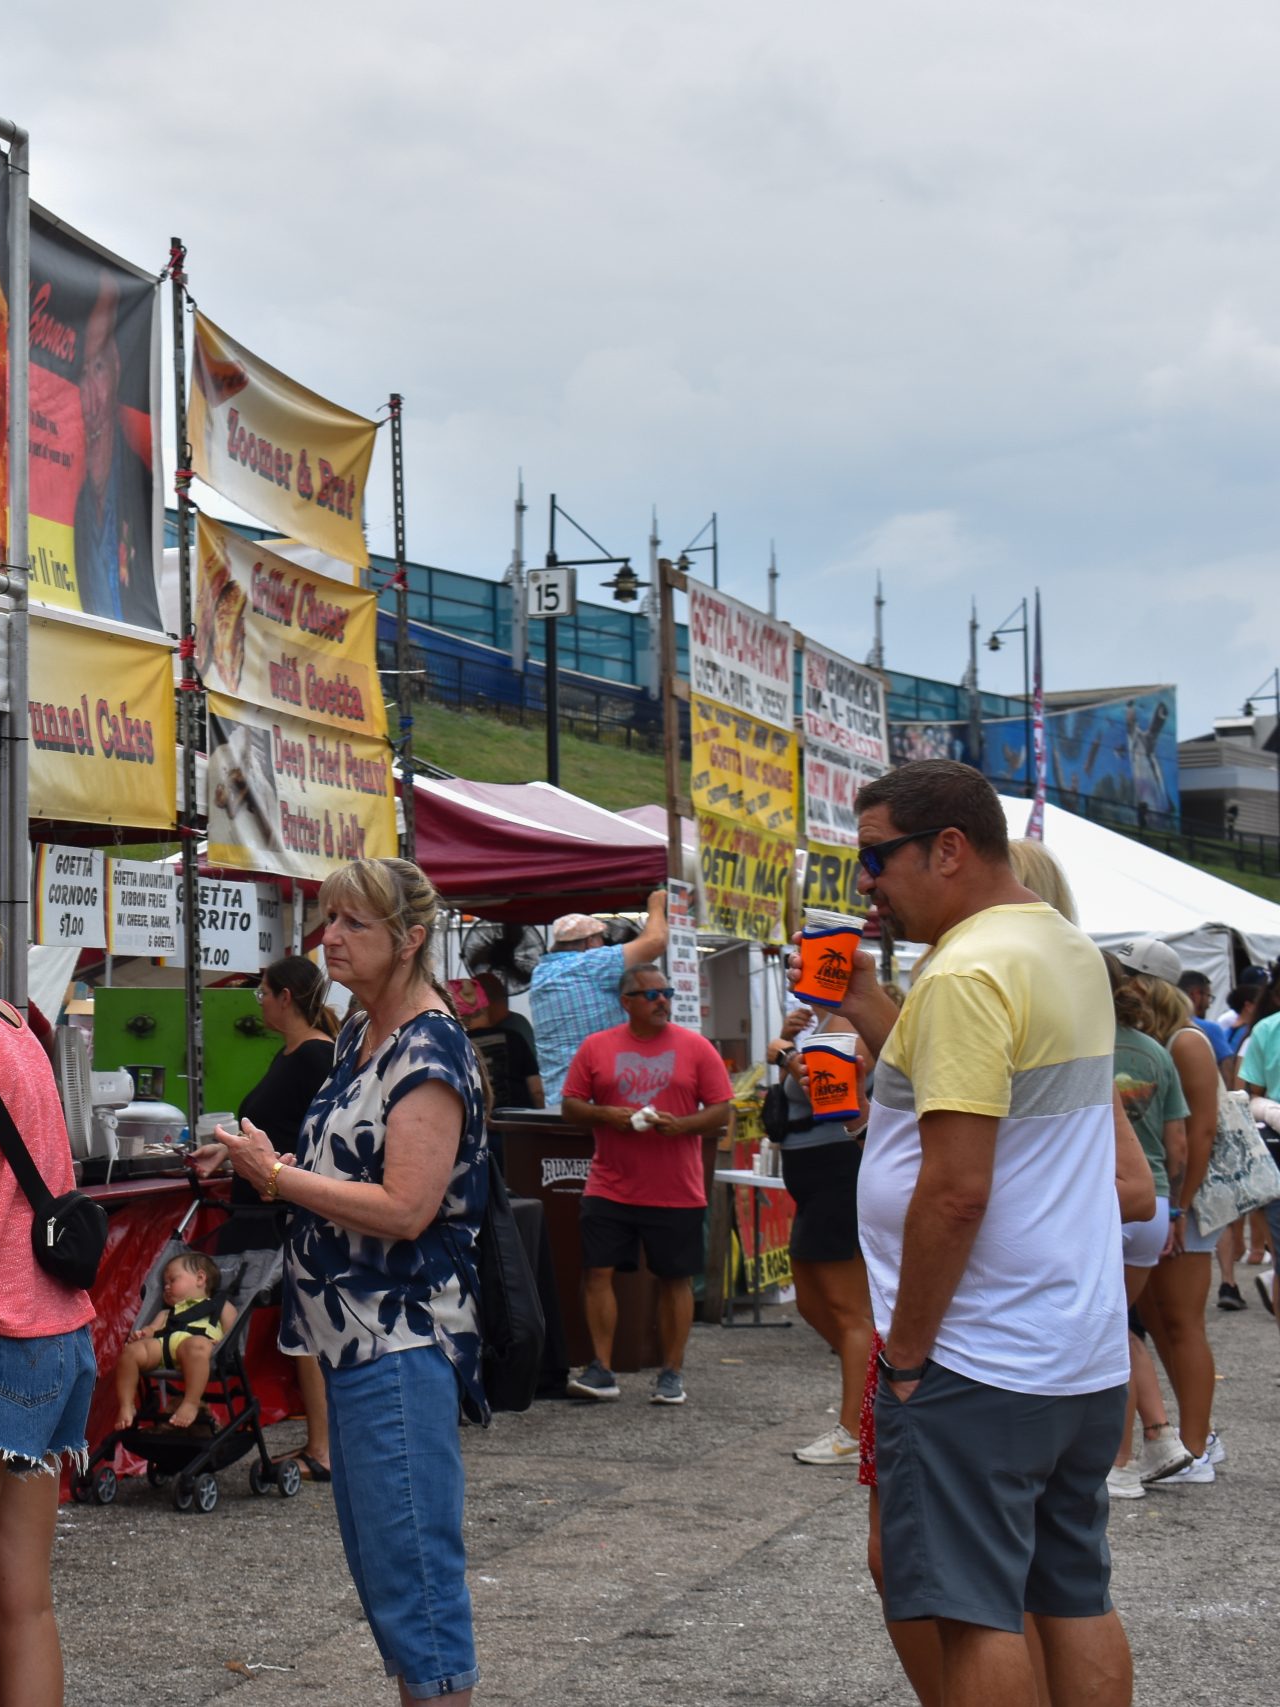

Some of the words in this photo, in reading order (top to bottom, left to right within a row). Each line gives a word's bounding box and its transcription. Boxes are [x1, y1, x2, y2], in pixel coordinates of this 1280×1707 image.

[297, 448, 313, 500] &
[317, 458, 355, 520] Brat
[251, 562, 299, 627] Grilled
[536, 584, 559, 611] 15
[269, 652, 302, 706] with
[305, 663, 365, 722] Goetta
[28, 694, 94, 756] unnel
[96, 699, 154, 765] Cakes
[273, 724, 306, 793] Deep
[308, 734, 343, 788] Fried
[344, 743, 387, 797] Peanut
[280, 800, 320, 856] Butter
[324, 809, 334, 858] &
[336, 812, 366, 860] Jelly
[56, 854, 92, 877] GOETTA
[113, 870, 137, 886] GOETTA
[139, 873, 172, 889] MOUNTAIN
[49, 884, 97, 906] CORNDOG
[121, 891, 145, 907] RIBBON
[148, 894, 167, 908] FRIES
[176, 883, 242, 908] GETTA
[176, 906, 250, 931] RRITO
[154, 936, 174, 948] GOETTA
[619, 1067, 669, 1096] Ohio
[542, 1158, 592, 1187] RUMP
